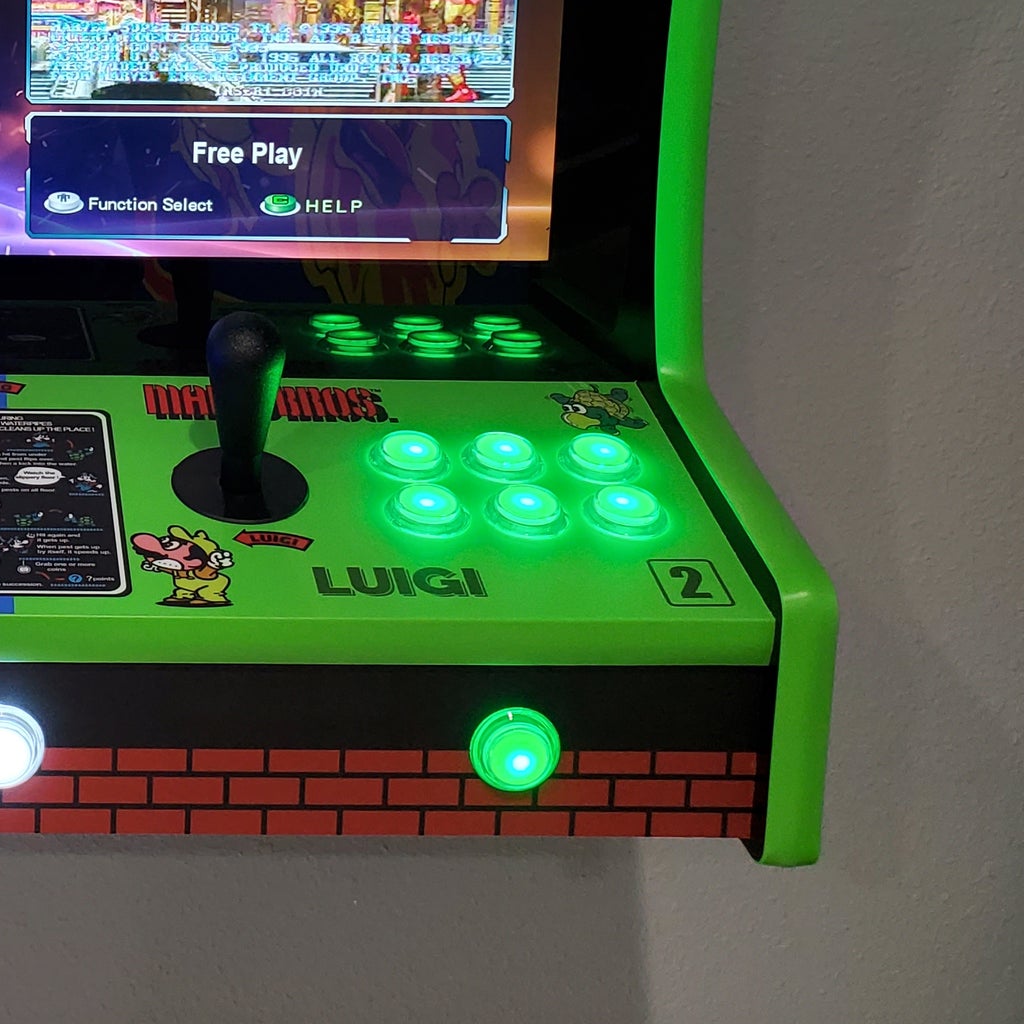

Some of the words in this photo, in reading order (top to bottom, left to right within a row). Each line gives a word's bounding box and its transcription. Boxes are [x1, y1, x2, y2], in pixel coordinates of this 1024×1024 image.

[192, 142, 244, 164] Free
[251, 142, 303, 170] Play
[88, 198, 157, 212] Function
[163, 198, 213, 213] Select
[306, 199, 364, 214] HELP
[249, 534, 299, 546] LUIGI
[311, 566, 489, 598] LUIGI
[669, 566, 714, 600] 2
